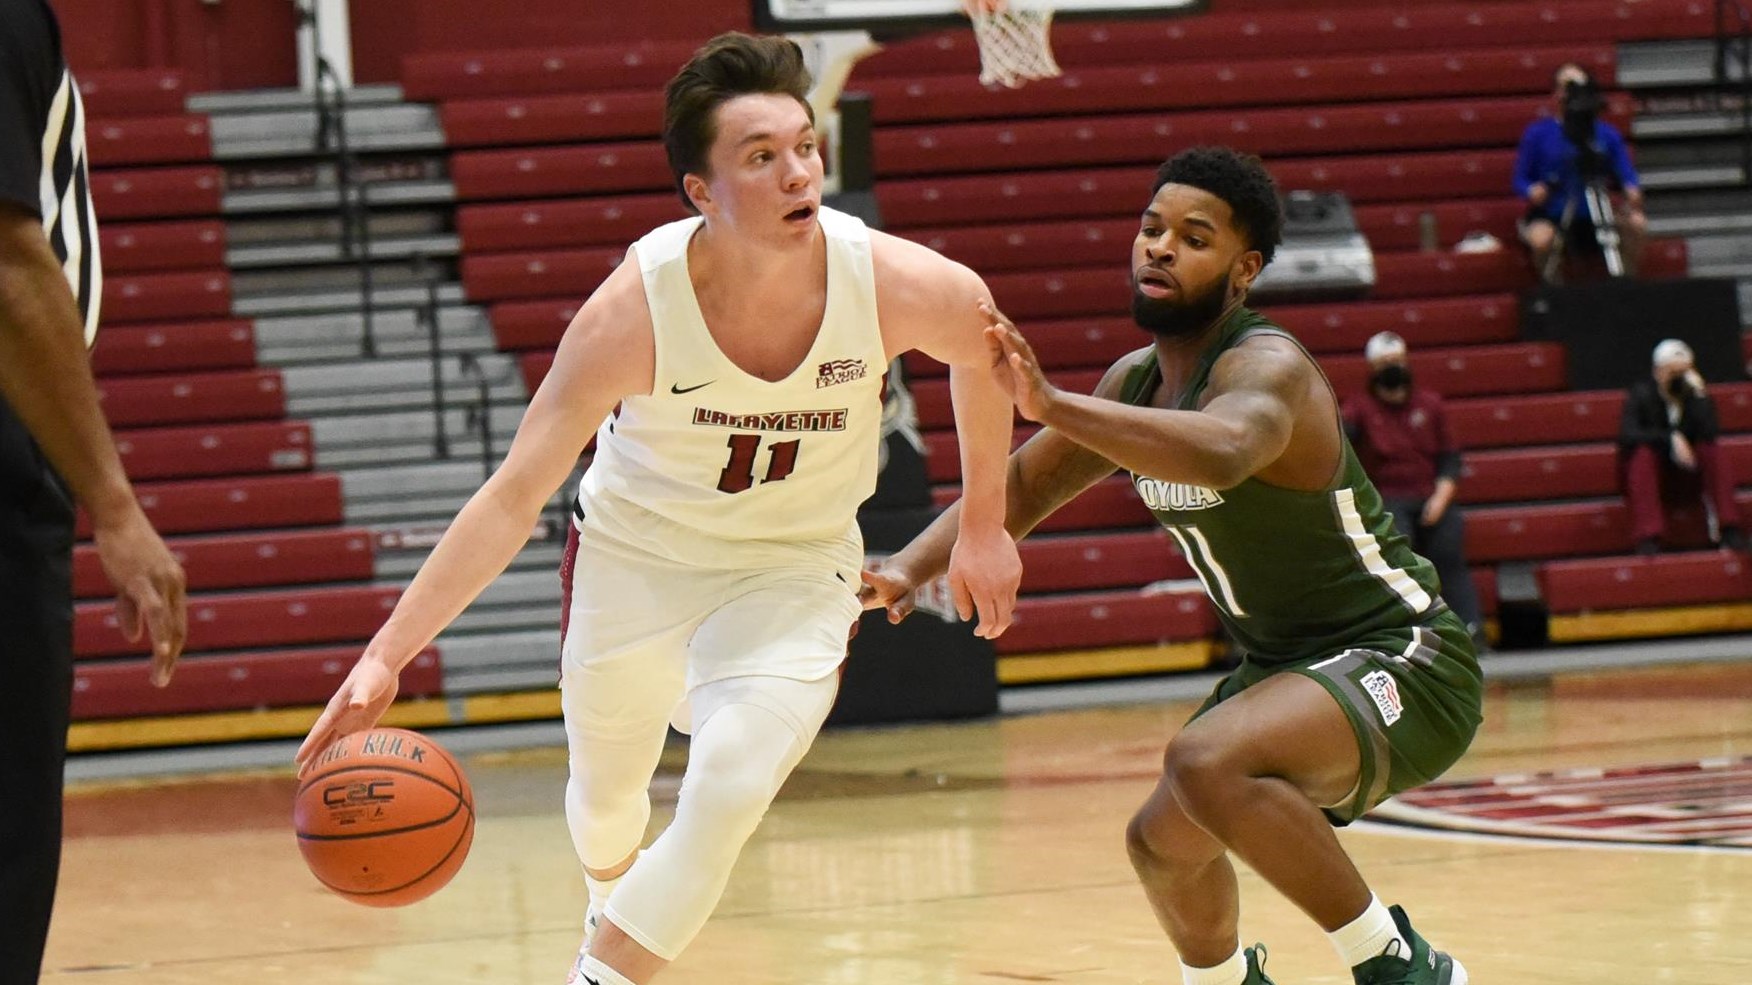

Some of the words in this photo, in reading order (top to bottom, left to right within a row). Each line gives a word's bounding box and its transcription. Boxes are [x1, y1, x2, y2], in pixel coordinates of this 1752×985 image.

[815, 371, 867, 389] LEAGUE
[816, 367, 866, 382] PATRIOT
[694, 408, 847, 431] LAFAYETTE
[717, 434, 800, 494] 11
[1137, 476, 1220, 510] OYOLA
[323, 781, 395, 805] C2C
